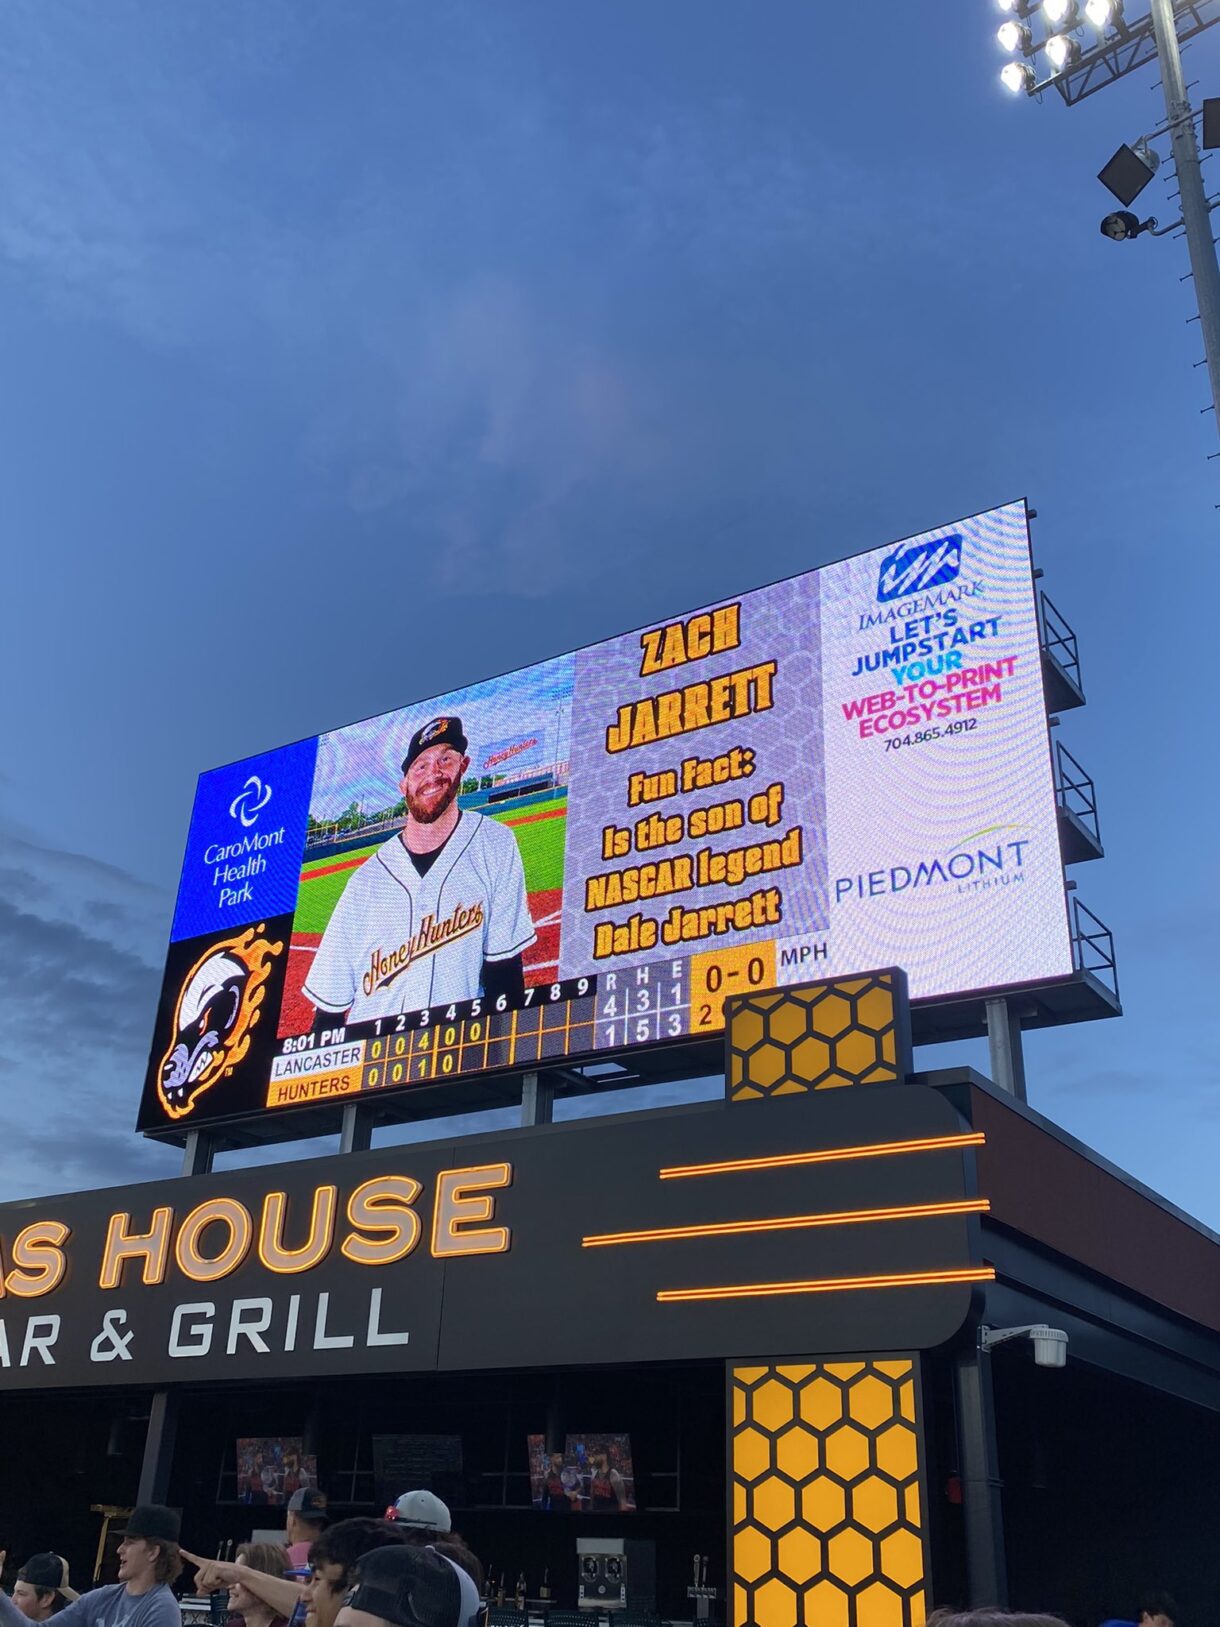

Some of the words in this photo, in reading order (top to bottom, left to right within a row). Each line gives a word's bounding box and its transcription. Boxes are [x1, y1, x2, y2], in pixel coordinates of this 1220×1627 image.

[858, 579, 984, 631] IMAGEMARK
[890, 608, 958, 645] LET'S
[640, 602, 741, 677] ZACH
[851, 616, 1001, 677] JUMPSTART
[891, 650, 963, 686] YOUR
[605, 659, 777, 754] JARRETT
[841, 655, 1019, 721] WEB-TO-PRINT
[859, 683, 1002, 739] ECOSYSTEM
[884, 718, 977, 752] 704.865.4912
[628, 771, 677, 807] Fun
[681, 746, 756, 793] Fact:
[204, 827, 285, 865] CaroMont
[602, 825, 631, 861] Is
[635, 812, 684, 851] the
[688, 799, 743, 839] son
[748, 782, 784, 826] of
[213, 853, 266, 886] Health
[219, 881, 253, 908] Park
[585, 854, 695, 912] NASCAR
[697, 826, 801, 886] legend
[835, 840, 1029, 903] PIEDMONT
[958, 872, 1025, 894] LITHIUM
[593, 913, 657, 960] Dale
[661, 886, 783, 946] Jarrett
[781, 942, 828, 967] MPH
[375, 1019, 382, 1035] 1
[395, 1015, 406, 1032] 2
[421, 1010, 430, 1026] 3
[446, 1004, 456, 1021] 4
[471, 999, 482, 1016] 5
[496, 994, 507, 1011] 6
[524, 989, 535, 1006] 7
[550, 983, 561, 1000] 8
[577, 978, 589, 995] 9
[606, 974, 617, 991] R
[637, 966, 649, 985] H
[673, 961, 683, 979] E
[274, 1046, 361, 1077] LANCASTER
[372, 1040, 381, 1059] 0
[395, 1037, 405, 1055] 0
[418, 1032, 429, 1050] 4
[444, 1027, 455, 1046] 0
[470, 1022, 481, 1041] 0
[603, 994, 617, 1017] 4
[637, 989, 650, 1011] 3
[671, 983, 681, 1005] 1
[278, 1075, 350, 1102] HUNTERS
[368, 1068, 378, 1086] 0
[392, 1063, 403, 1082] 0
[418, 1058, 426, 1077] 1
[442, 1054, 453, 1072] 0
[605, 1027, 616, 1047] 1
[637, 1019, 649, 1041] 5
[668, 1014, 682, 1036] 3
[699, 1004, 712, 1026] 2
[282, 1032, 315, 1054] 8:01
[320, 1027, 346, 1047] PM
[0, 1220, 71, 1299] S
[99, 1162, 512, 1290] HOUSE
[90, 1309, 135, 1362] &
[168, 1287, 410, 1358] GRILL
